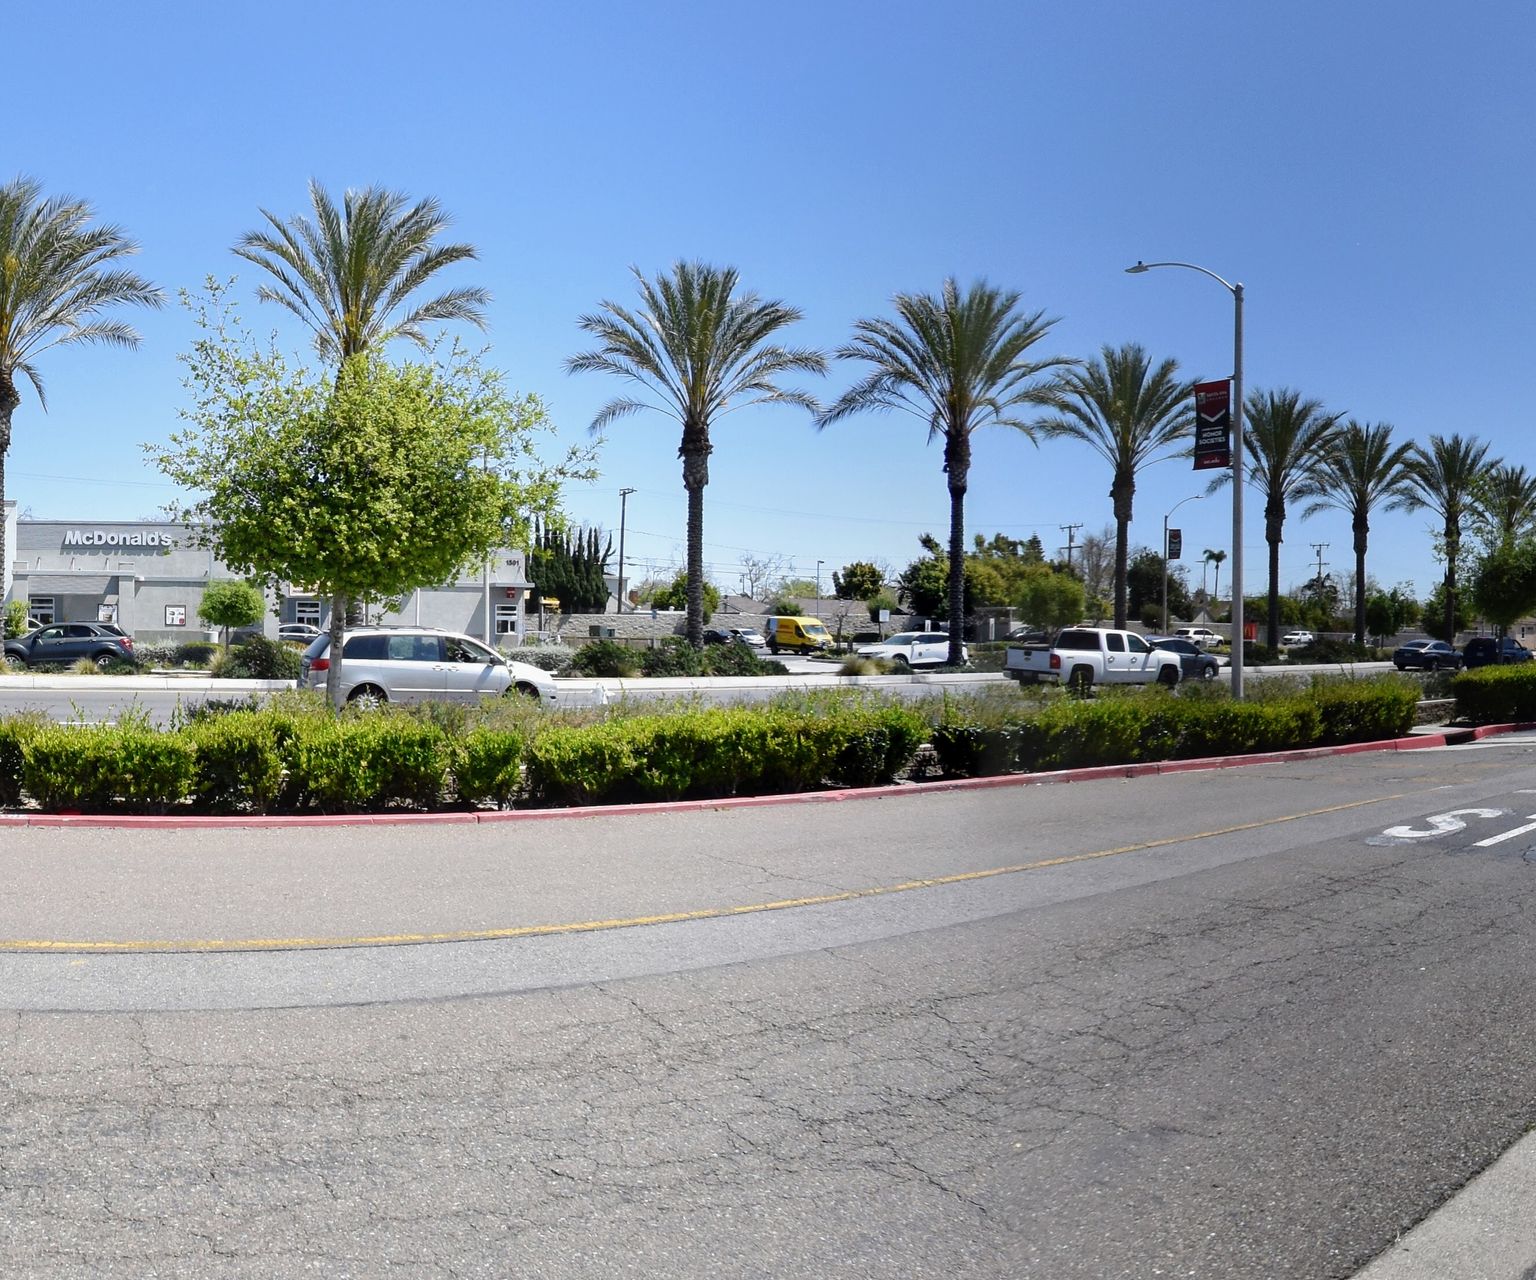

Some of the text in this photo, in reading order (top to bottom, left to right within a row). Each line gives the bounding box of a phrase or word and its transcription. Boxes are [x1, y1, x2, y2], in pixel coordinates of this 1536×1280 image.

[1202, 430, 1222, 438] HONOR
[1199, 437, 1226, 445] SOCIETIES
[64, 530, 173, 546] McDonald's
